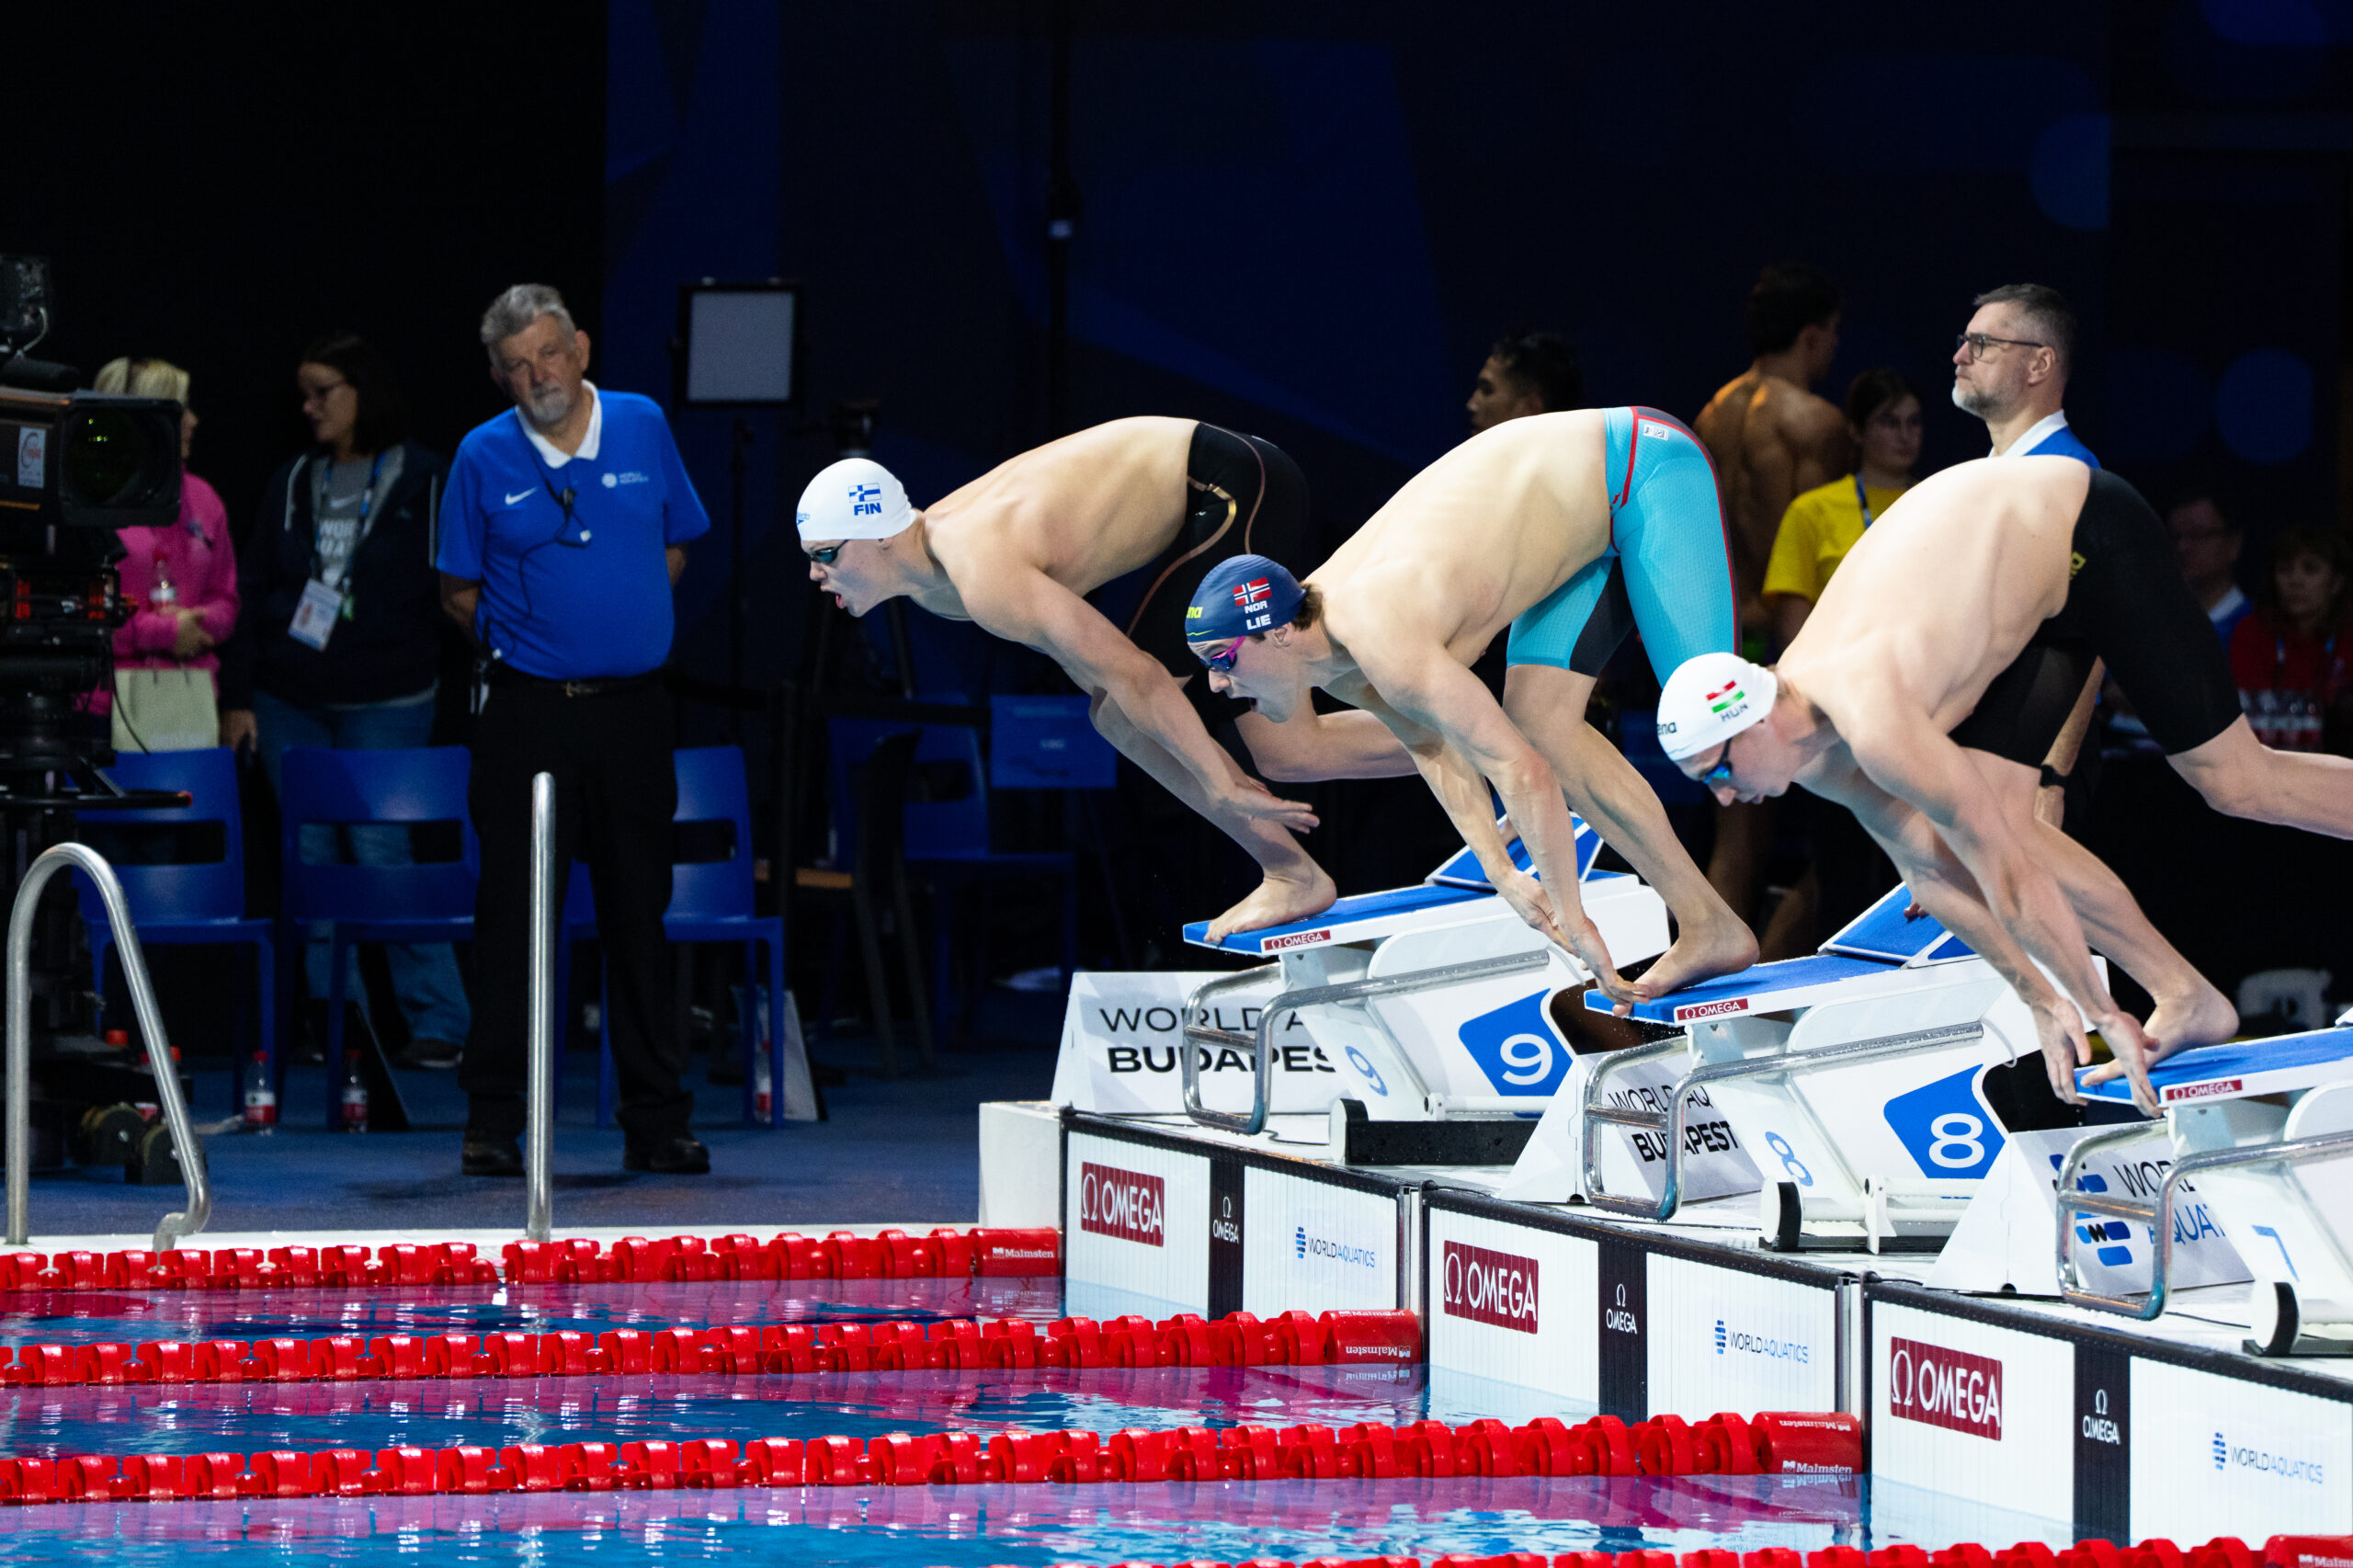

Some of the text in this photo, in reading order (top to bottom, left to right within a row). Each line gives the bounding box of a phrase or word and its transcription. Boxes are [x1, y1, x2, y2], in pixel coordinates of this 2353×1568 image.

[854, 503, 881, 516] FIN
[1245, 600, 1267, 614] NOR
[1246, 614, 1271, 630] LIE
[1720, 703, 1748, 722] HUN
[1284, 932, 1324, 946] OMEGA
[1699, 1000, 1742, 1017] OMEGA
[1500, 1033, 1552, 1085] 9
[1345, 1045, 1388, 1096] 9
[2188, 1081, 2234, 1098] OMEGA
[1928, 1112, 1985, 1169] 8
[1765, 1131, 1813, 1187] 8
[1102, 1179, 1164, 1237] OMEGA
[1212, 1218, 1239, 1244] OMEGA
[1005, 1248, 1054, 1258] Malmsten
[2251, 1224, 2300, 1282] 7
[1467, 1260, 1538, 1322] OMEGA
[1606, 1307, 1638, 1335] OMEGA
[1346, 1346, 1397, 1356] Malmsten
[1918, 1358, 2002, 1428] OMEGA
[1779, 1420, 1837, 1430] Malmsten
[2082, 1414, 2121, 1447] OMEGA
[1796, 1462, 1853, 1474] Malmsten
